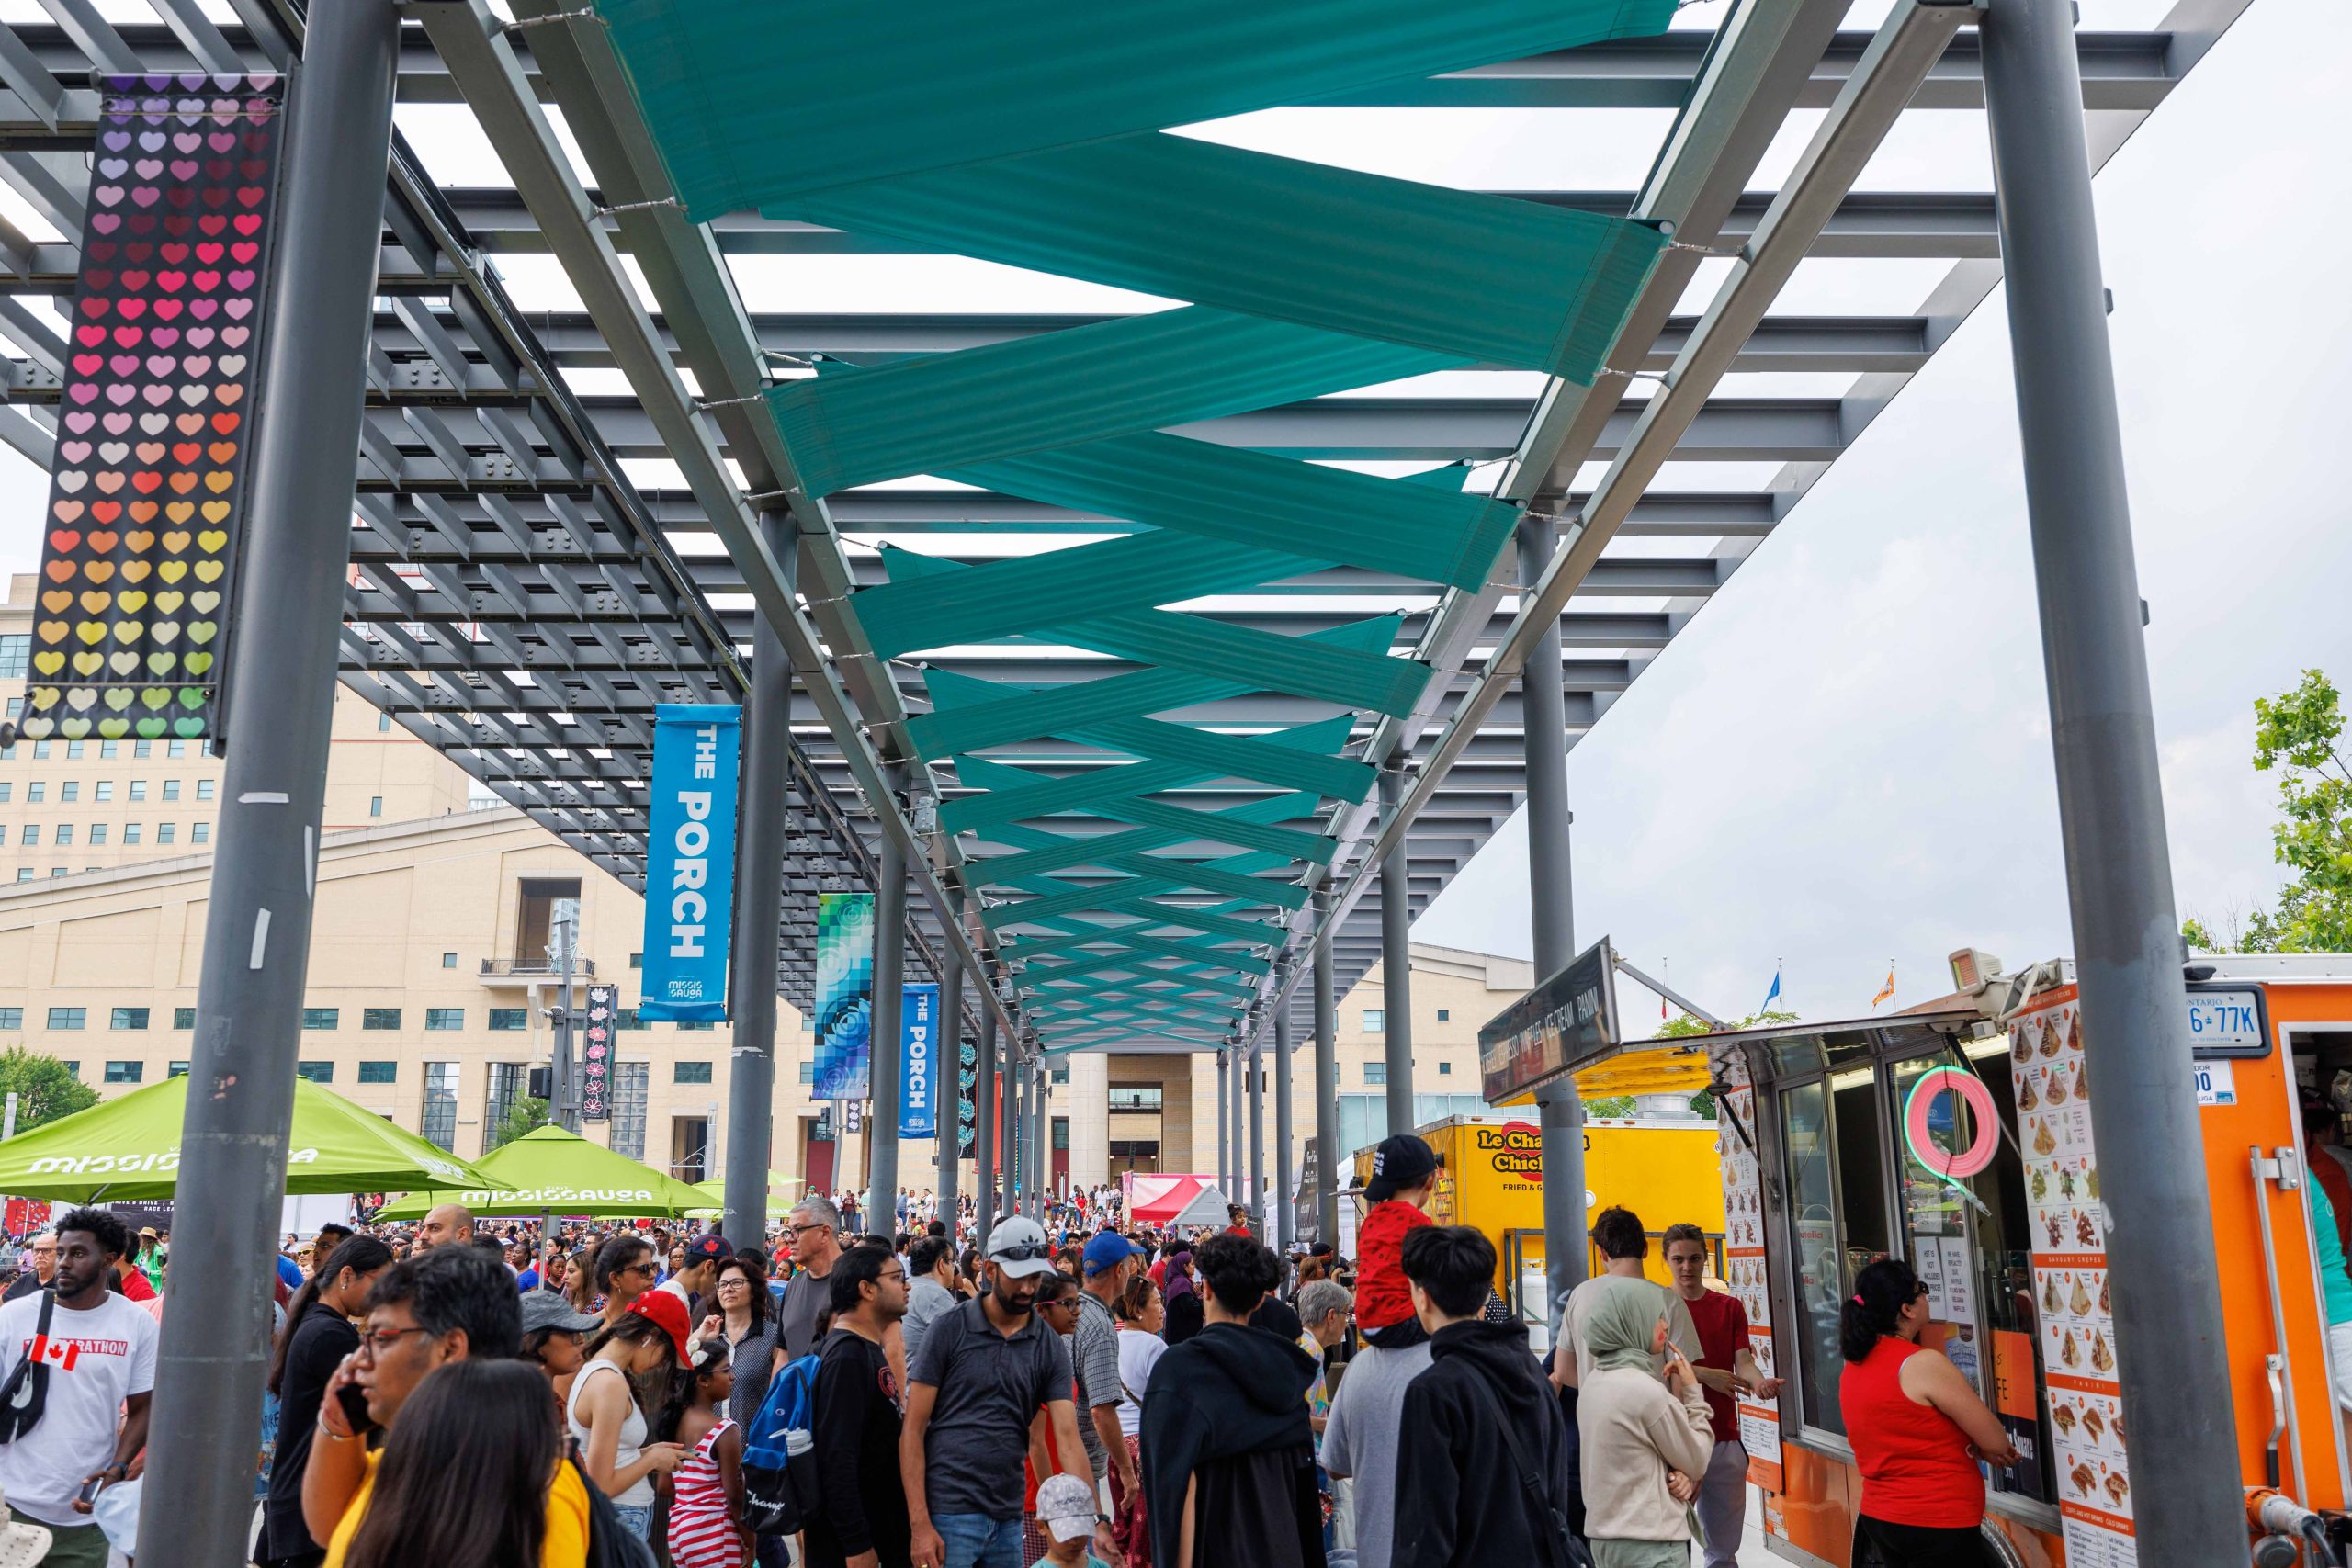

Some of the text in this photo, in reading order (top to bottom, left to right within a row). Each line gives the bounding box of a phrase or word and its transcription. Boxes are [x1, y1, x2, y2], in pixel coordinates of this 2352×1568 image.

[695, 723, 718, 780] THE
[669, 791, 711, 959] PORCH
[668, 980, 703, 989] MISSIS
[670, 988, 703, 999] SAUGA
[2186, 998, 2222, 1007] NTARIO
[1544, 1013, 1555, 1039] ICE
[1555, 1000, 1575, 1034] CREAM
[1577, 986, 1600, 1021] PANINI
[909, 993, 929, 1108] THE PORCH
[1477, 1130, 1505, 1149] Le
[1503, 1183, 1527, 1191] FRIED
[461, 1189, 653, 1203] MISSISSAUGA
[69, 1340, 128, 1356] RATHON
[2073, 1379, 2105, 1390] PANINI
